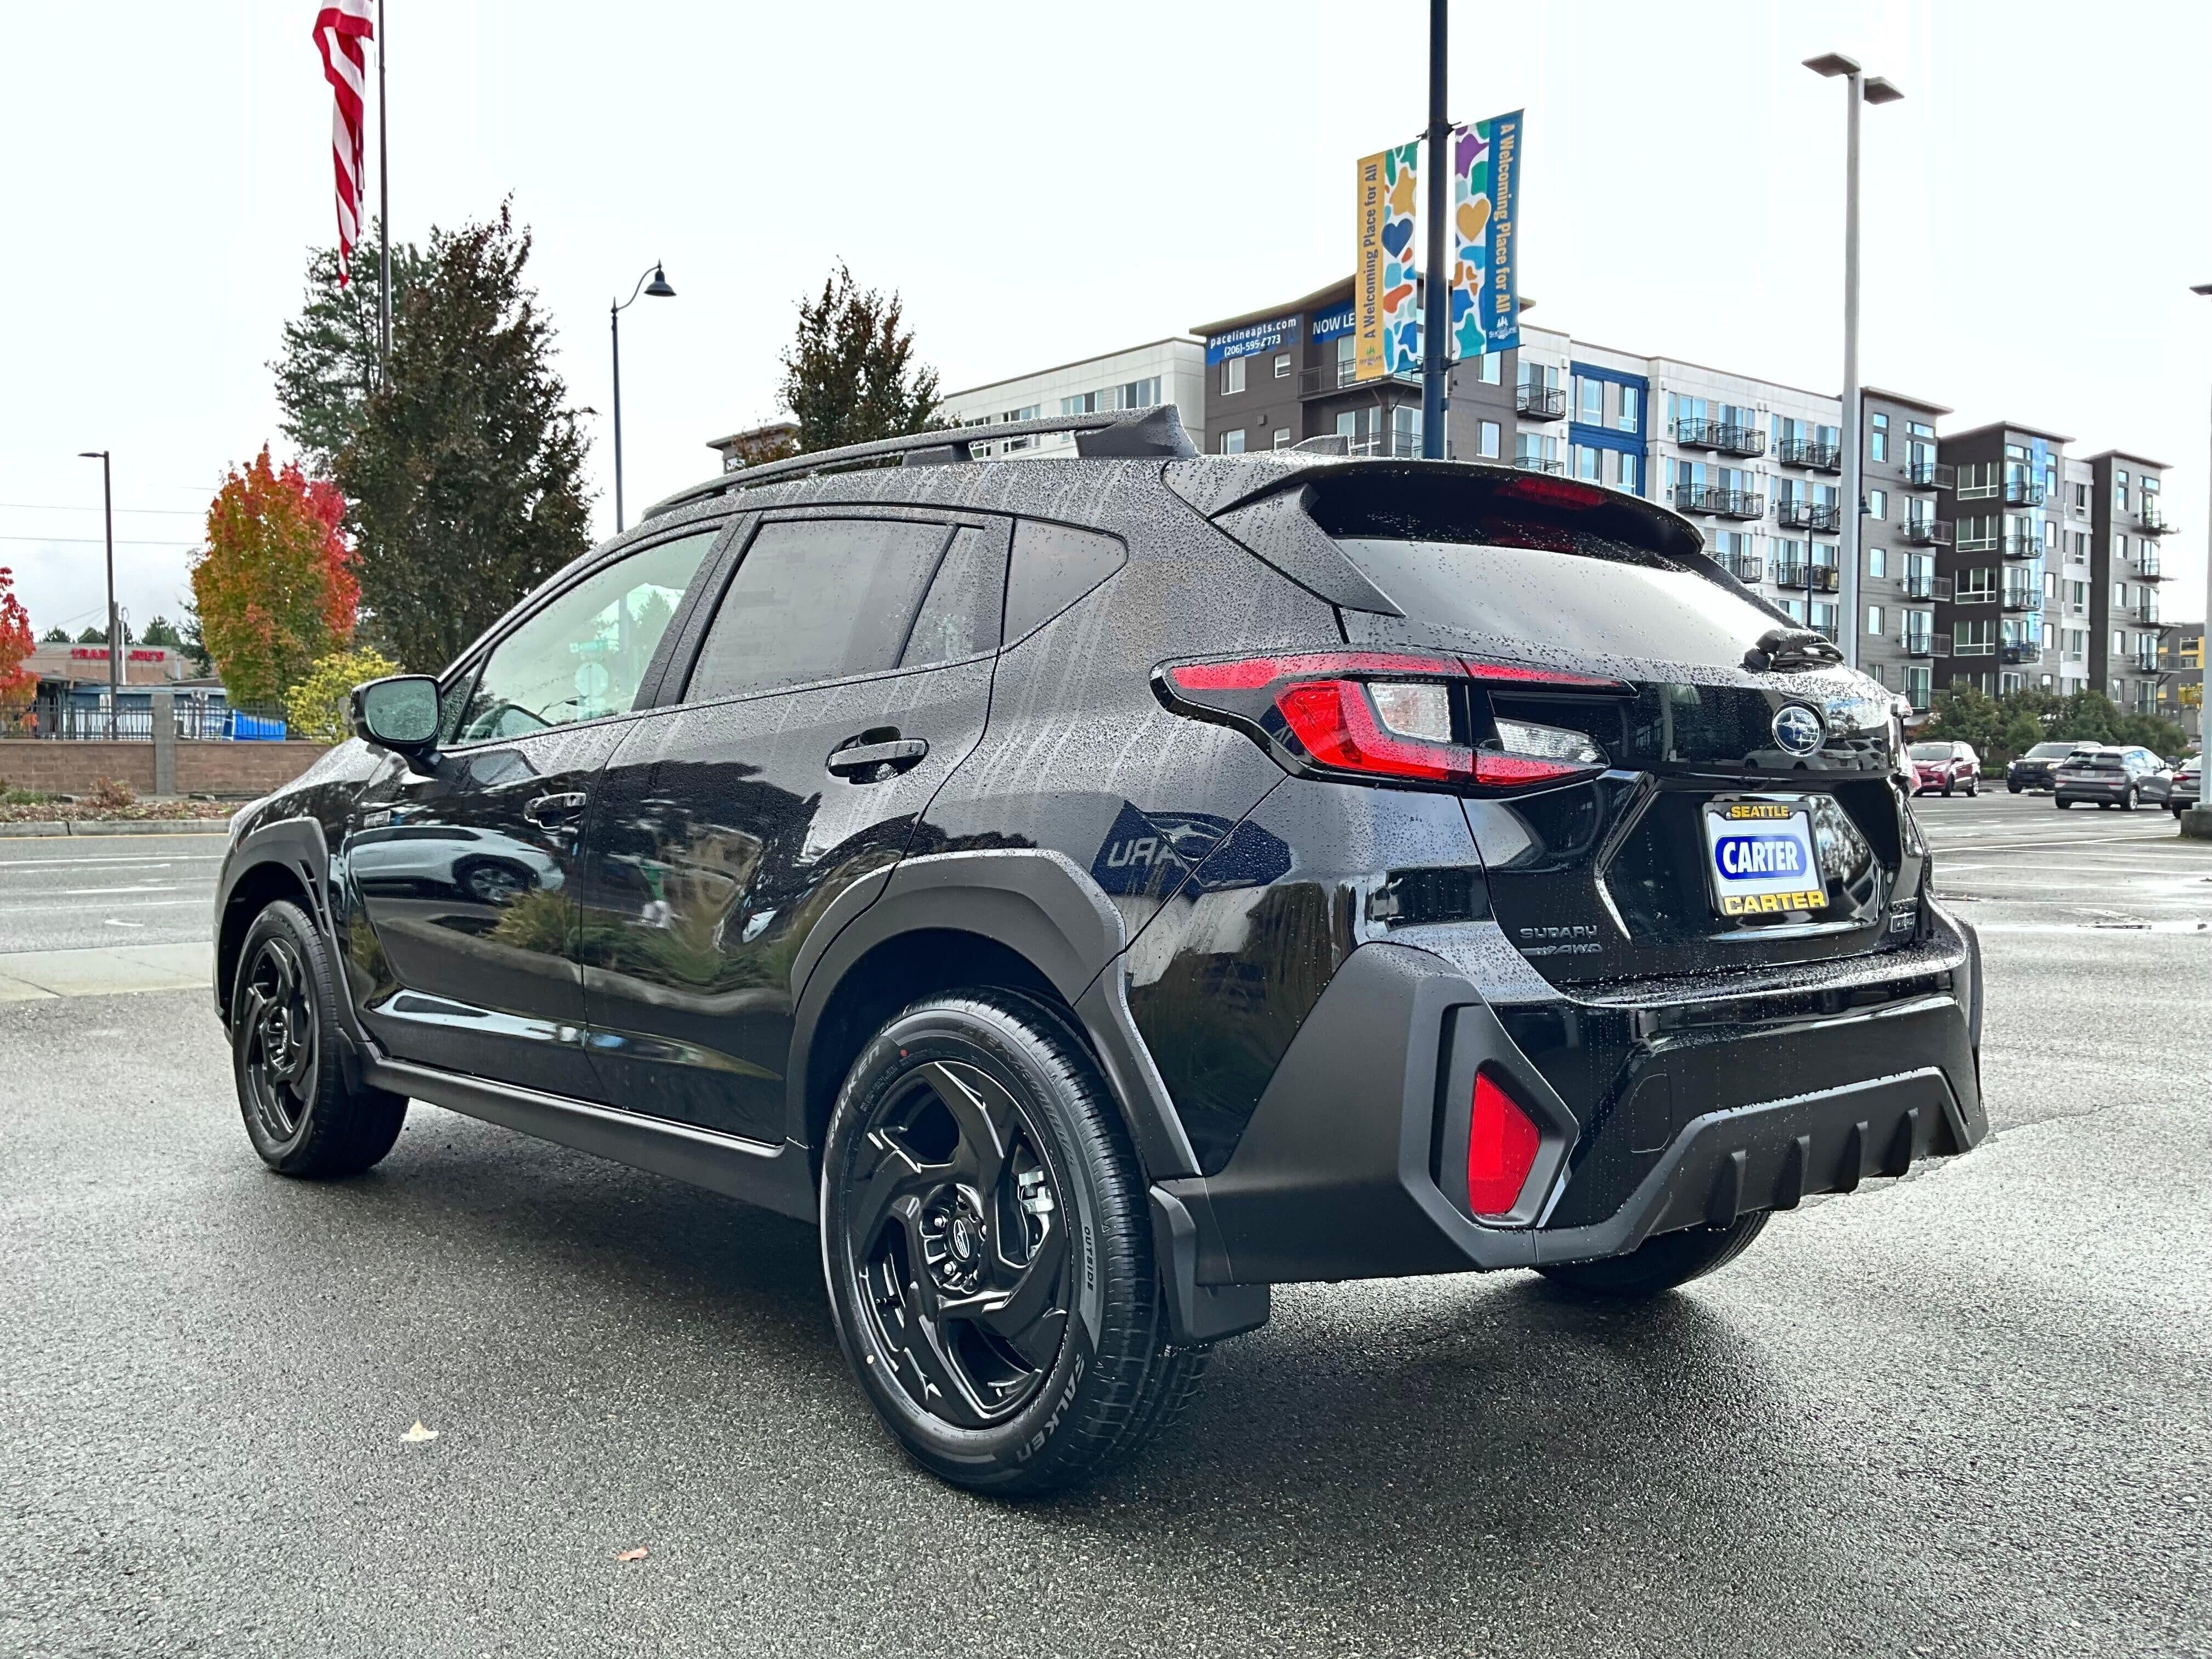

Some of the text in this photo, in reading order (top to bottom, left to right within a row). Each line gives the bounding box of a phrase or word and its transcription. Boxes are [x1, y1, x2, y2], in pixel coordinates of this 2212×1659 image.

[1494, 124, 1515, 313] A Welcoming Place for All
[1363, 164, 1378, 338] A Welcoming Place for All
[1210, 318, 1296, 349] pacelineapts.com
[1313, 316, 1341, 335] NOW
[71, 648, 123, 661] TRAD
[1731, 805, 1789, 818] SEATTLE
[1723, 841, 1799, 874] CARTER
[1724, 891, 1826, 915] CARTER
[1520, 925, 1597, 939] SUBARU
[1553, 943, 1603, 955] AWD
[1084, 1226, 1093, 1292] OUTSIDE
